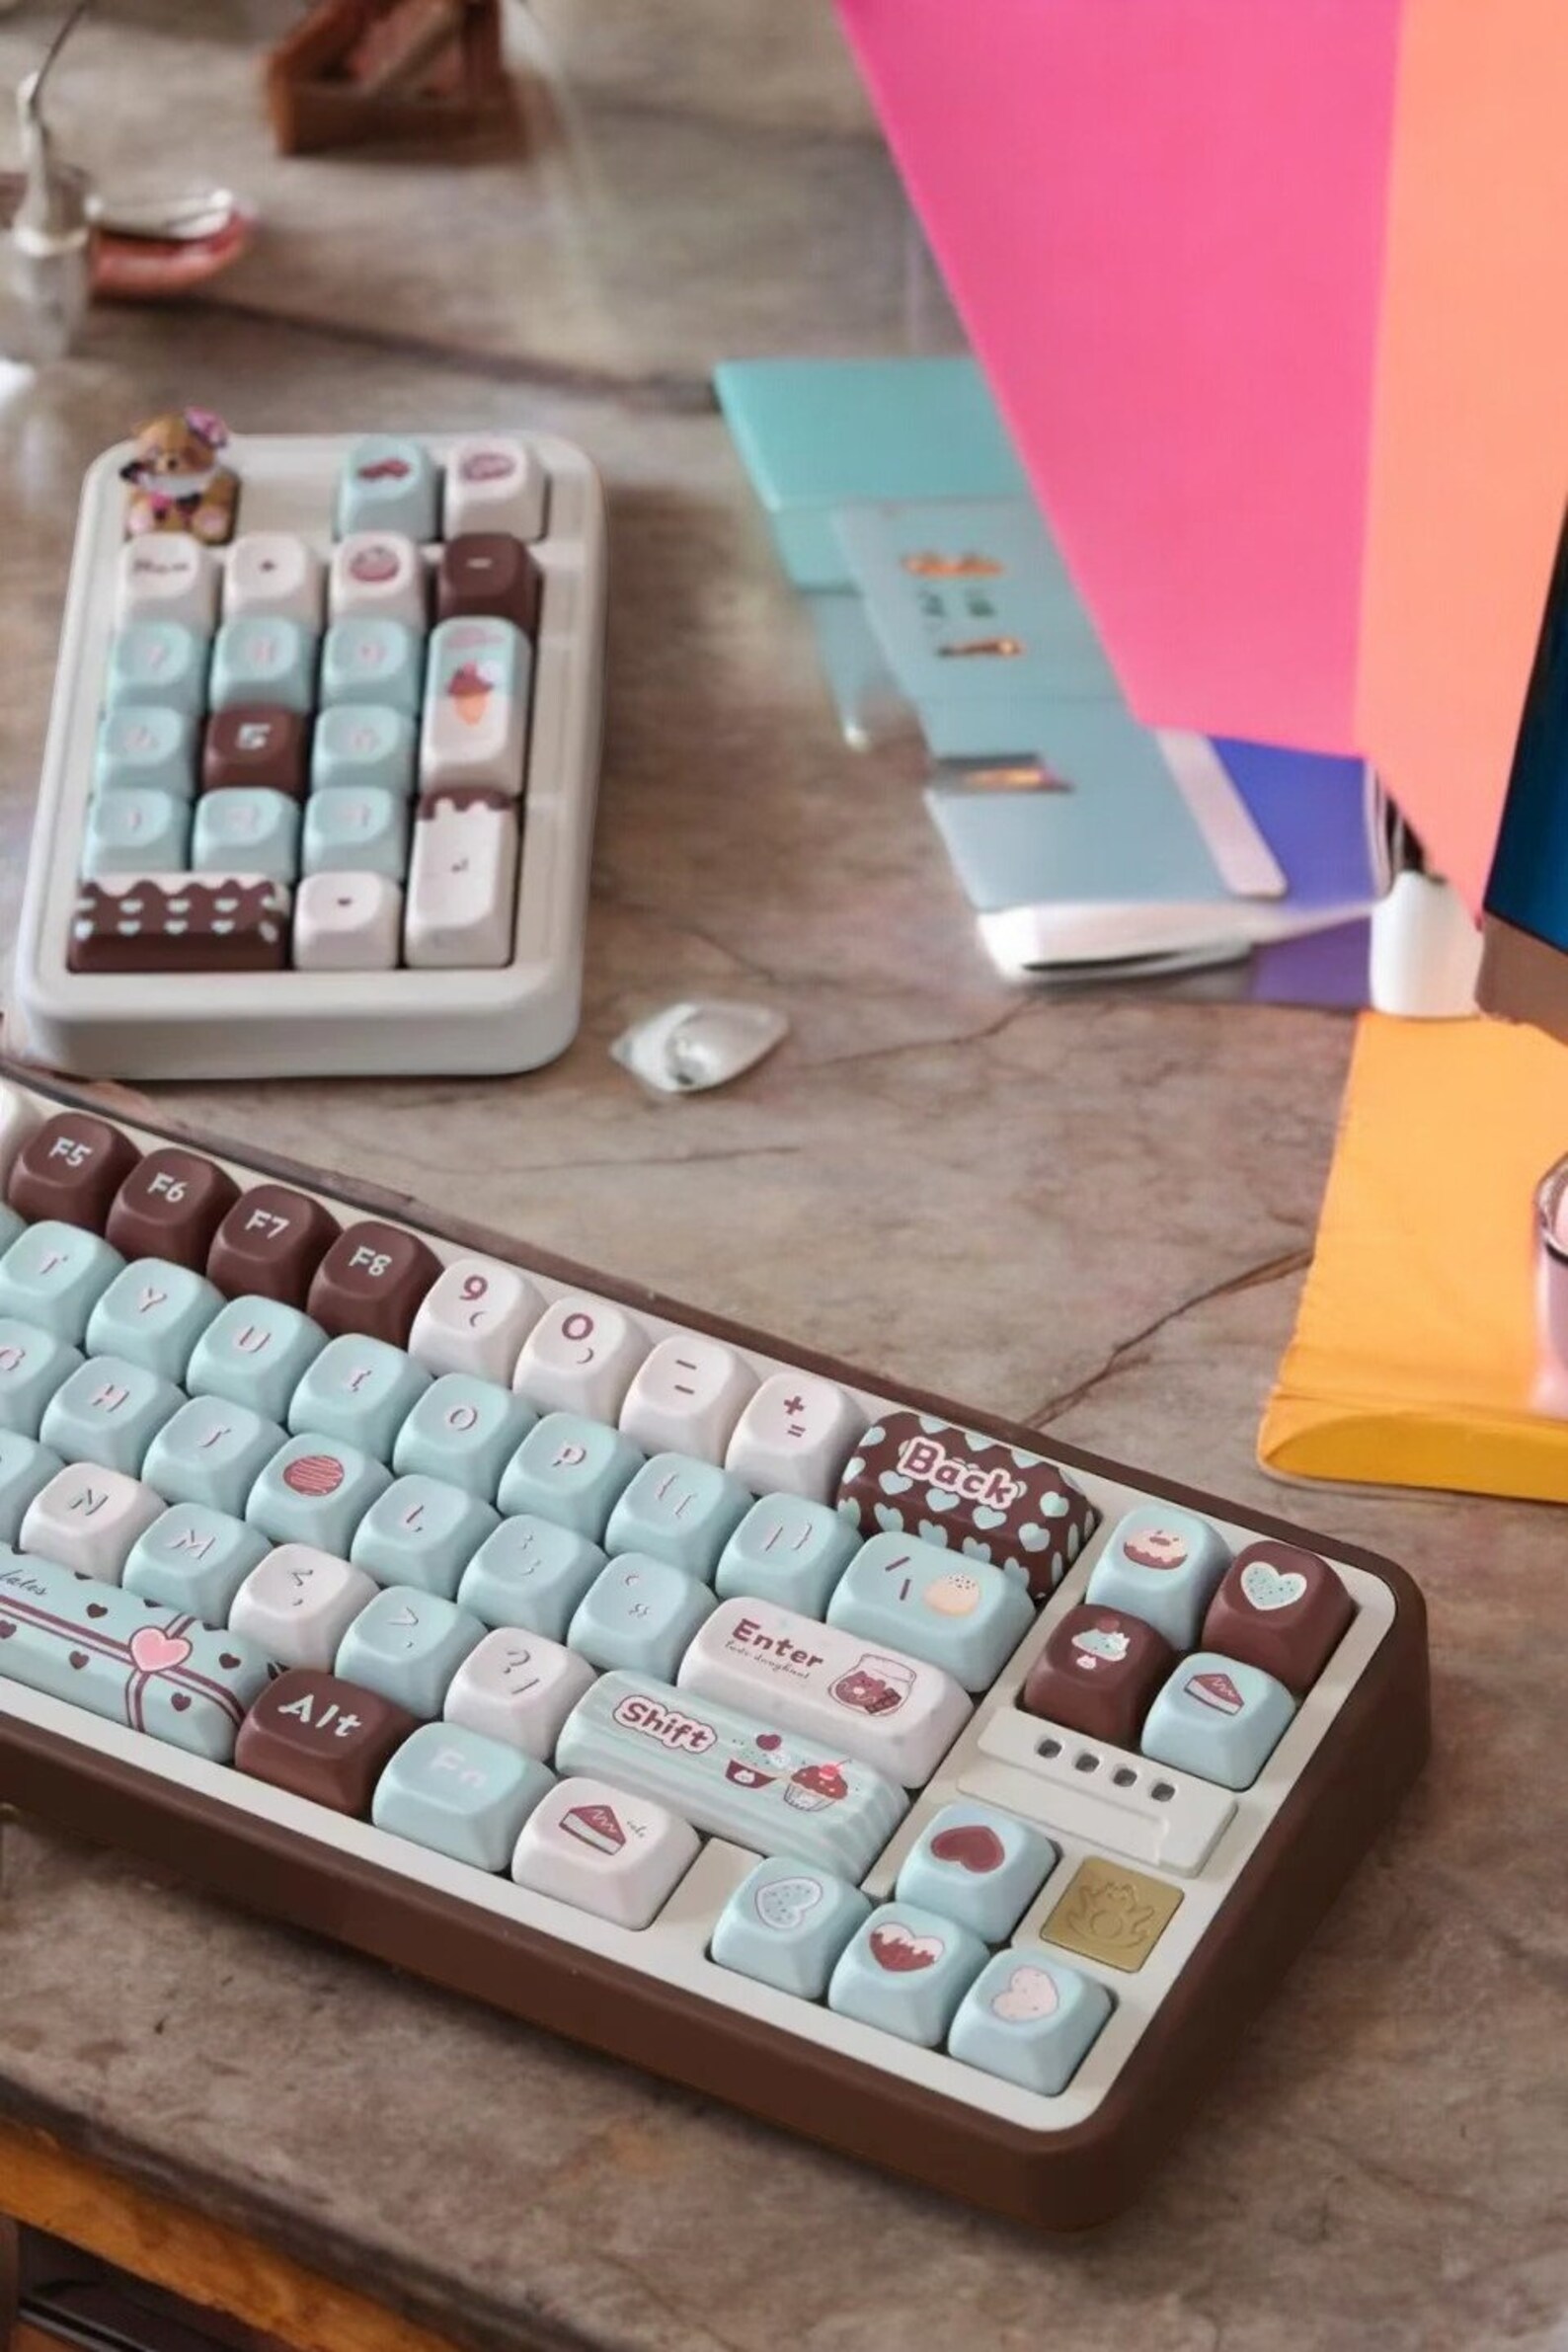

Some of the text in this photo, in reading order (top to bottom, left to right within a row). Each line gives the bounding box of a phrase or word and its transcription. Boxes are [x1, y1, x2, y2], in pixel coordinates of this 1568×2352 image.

[49, 1137, 92, 1167] F5
[147, 1172, 188, 1203] F6
[245, 1209, 290, 1238] F7
[349, 1246, 392, 1276] F8
[459, 1276, 488, 1301] 9
[902, 1441, 1012, 1506] Back
[732, 1617, 824, 1668] Enter
[277, 1692, 362, 1738] Alt
[620, 1700, 709, 1752] Shift
